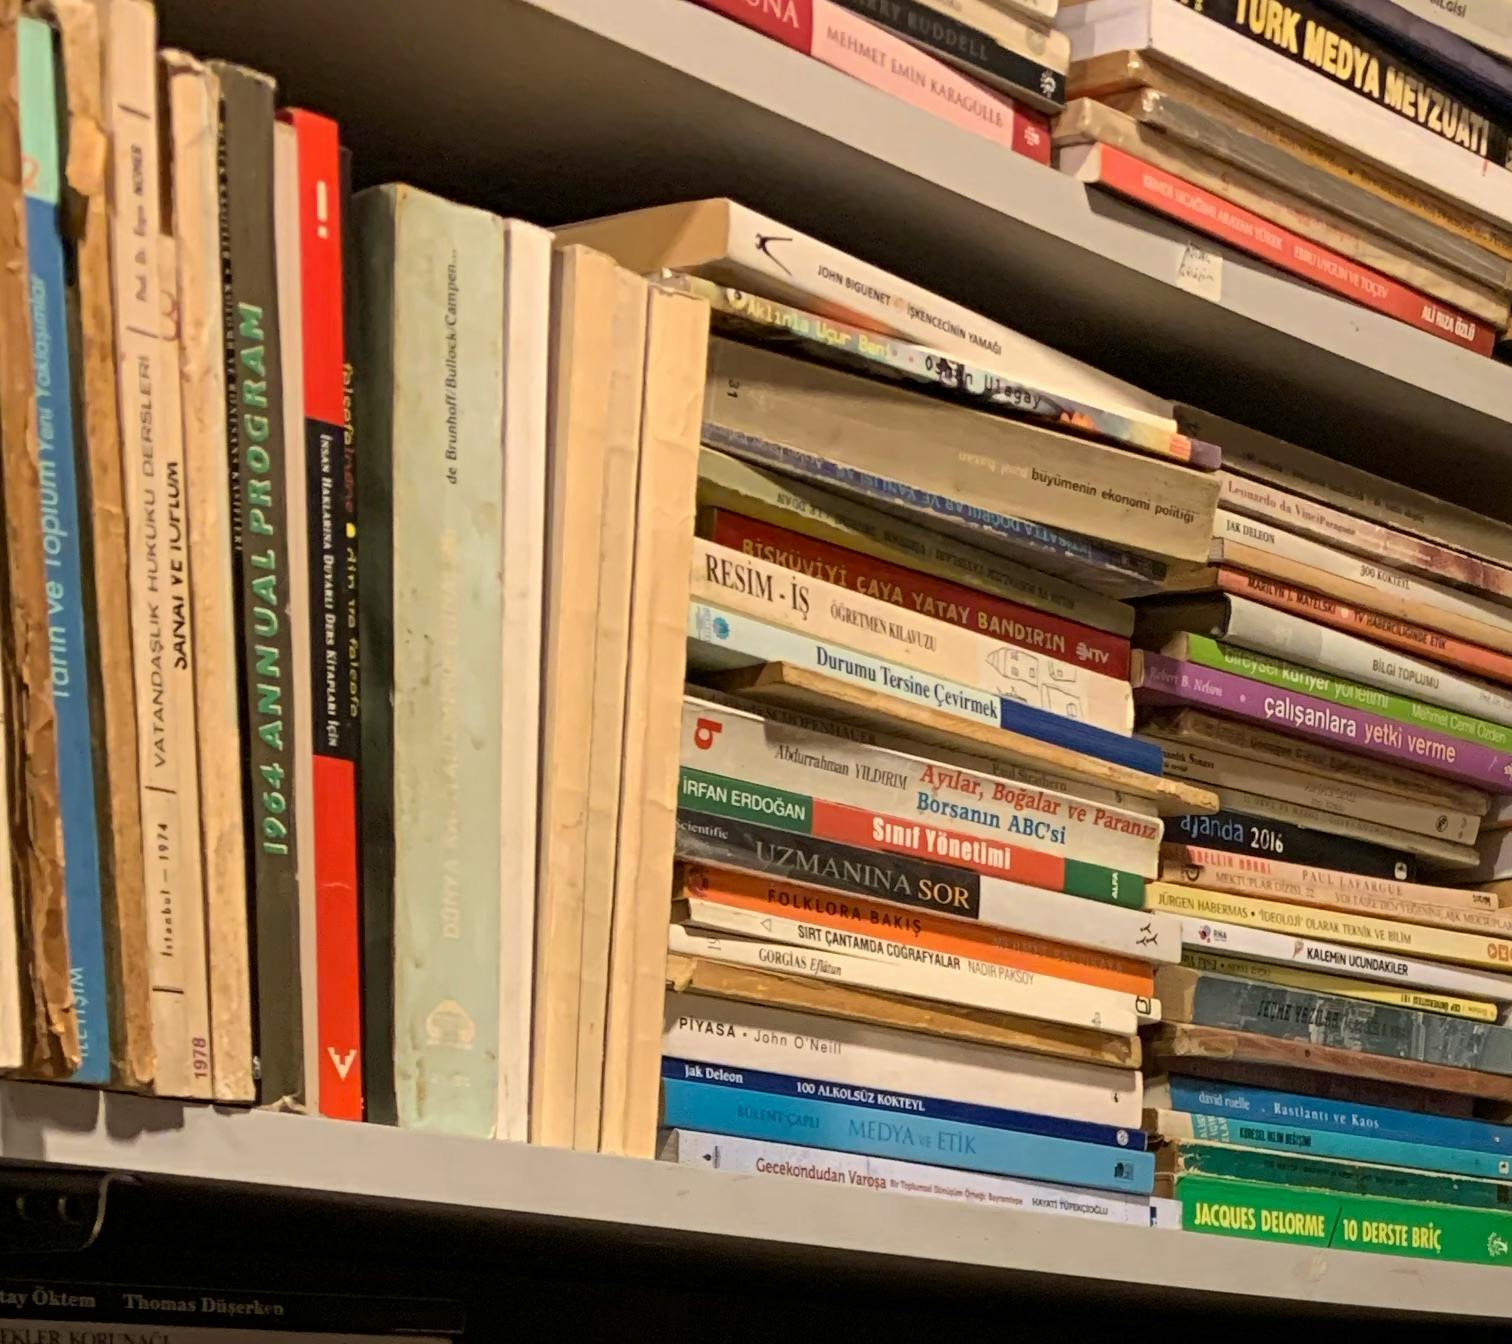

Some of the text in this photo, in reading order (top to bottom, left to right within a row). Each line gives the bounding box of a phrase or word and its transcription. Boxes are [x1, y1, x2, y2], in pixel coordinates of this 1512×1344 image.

[1302, 21, 1383, 96] MEDYA
[1384, 67, 1490, 158] MEVZUATI
[237, 301, 276, 539] PROGRAM
[704, 553, 809, 621] RESİM İŞ
[742, 536, 1065, 654] BİSKÜVİYİ ÇAYA YATAY BANDIRIN
[250, 546, 285, 752] ANNUAL
[815, 644, 999, 721] Durumu Tersine Çevirmek
[1264, 695, 1456, 763] çalışanlara yetki verme
[261, 762, 289, 856] 1964
[682, 776, 806, 822] İRFAN ERDOĞAN
[916, 792, 1067, 847] Borsanın ABC'si
[919, 764, 1157, 841] Ayılar, Boğalar ve Paranız
[872, 815, 1012, 871] Sınıf Yönetimi
[1180, 814, 1284, 854] ajanda 2016
[754, 840, 969, 910] UZMANINA SOR
[767, 888, 923, 937] FOLKLORA BAKIŞ
[1158, 890, 1248, 919] JÜRGEN HABERMAS
[1306, 945, 1408, 976] KALEMİN UCUNDAKİLER
[678, 1015, 843, 1056] PİYASA John O'Neill
[755, 1158, 887, 1191] Gecekondudan Varoşa
[1195, 1204, 1325, 1238] JACQUES DELORME
[1343, 1218, 1442, 1254] 10 DERSTE BRİÇ
